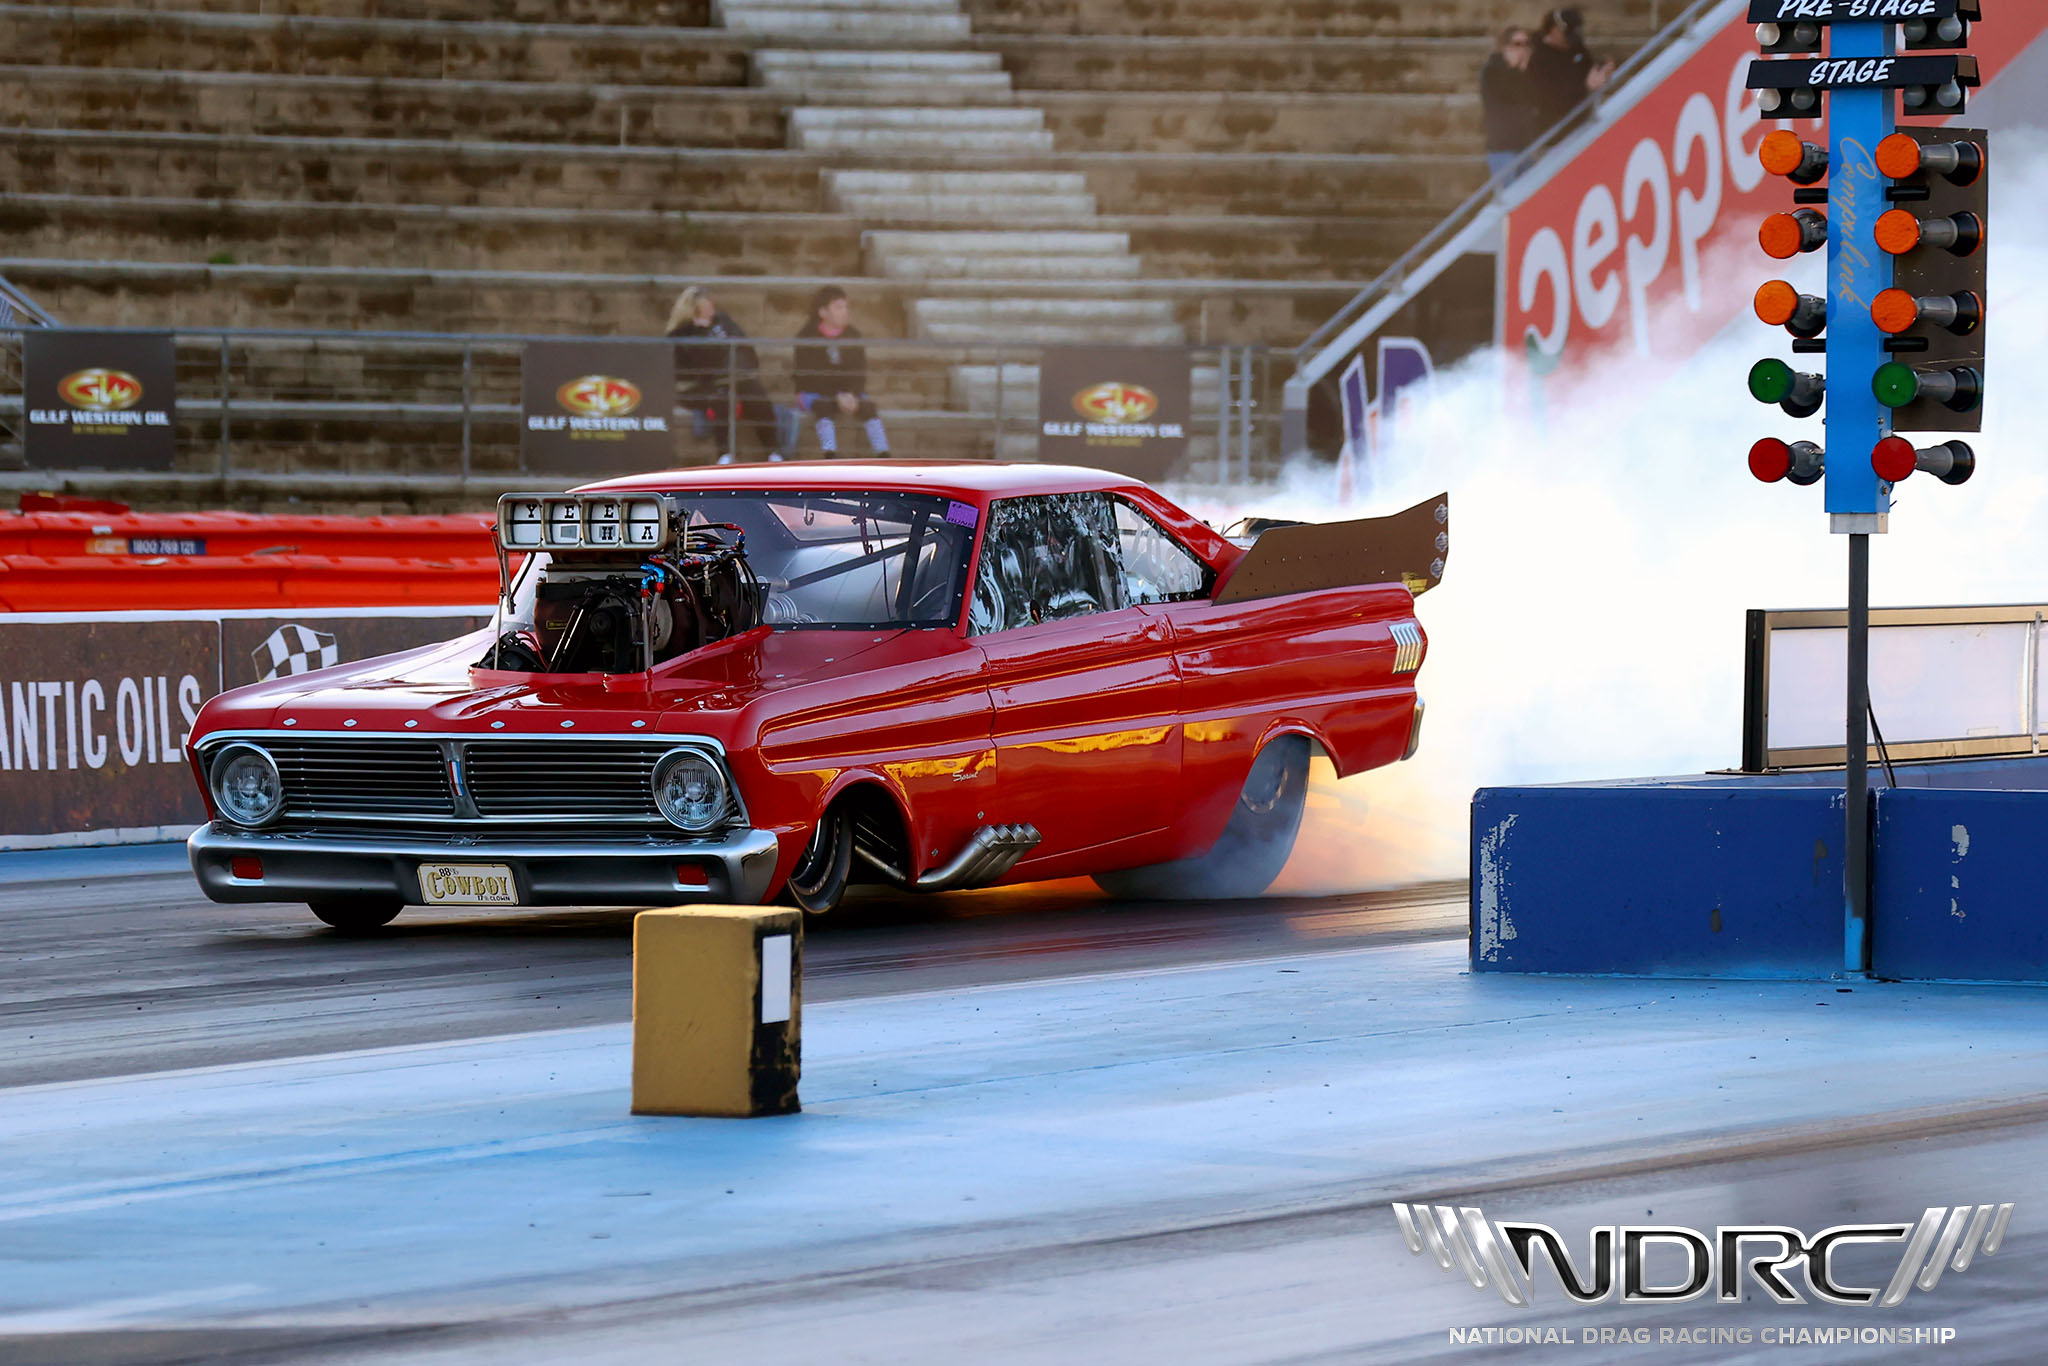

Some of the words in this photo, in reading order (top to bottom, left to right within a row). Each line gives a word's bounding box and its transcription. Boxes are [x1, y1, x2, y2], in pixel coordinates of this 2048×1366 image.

[1777, 0, 1936, 18] PRE-STAGE
[1808, 59, 1895, 84] STAGE
[1830, 137, 1877, 310] Compulink
[29, 410, 69, 424] GULF
[71, 410, 143, 425] WESTERN
[145, 411, 170, 425] OIL
[527, 415, 567, 430] GULF
[569, 415, 640, 431] WESTERN
[643, 416, 668, 431] OIL
[1085, 422, 1156, 437] WESTERN
[427, 871, 508, 899] COWBOY
